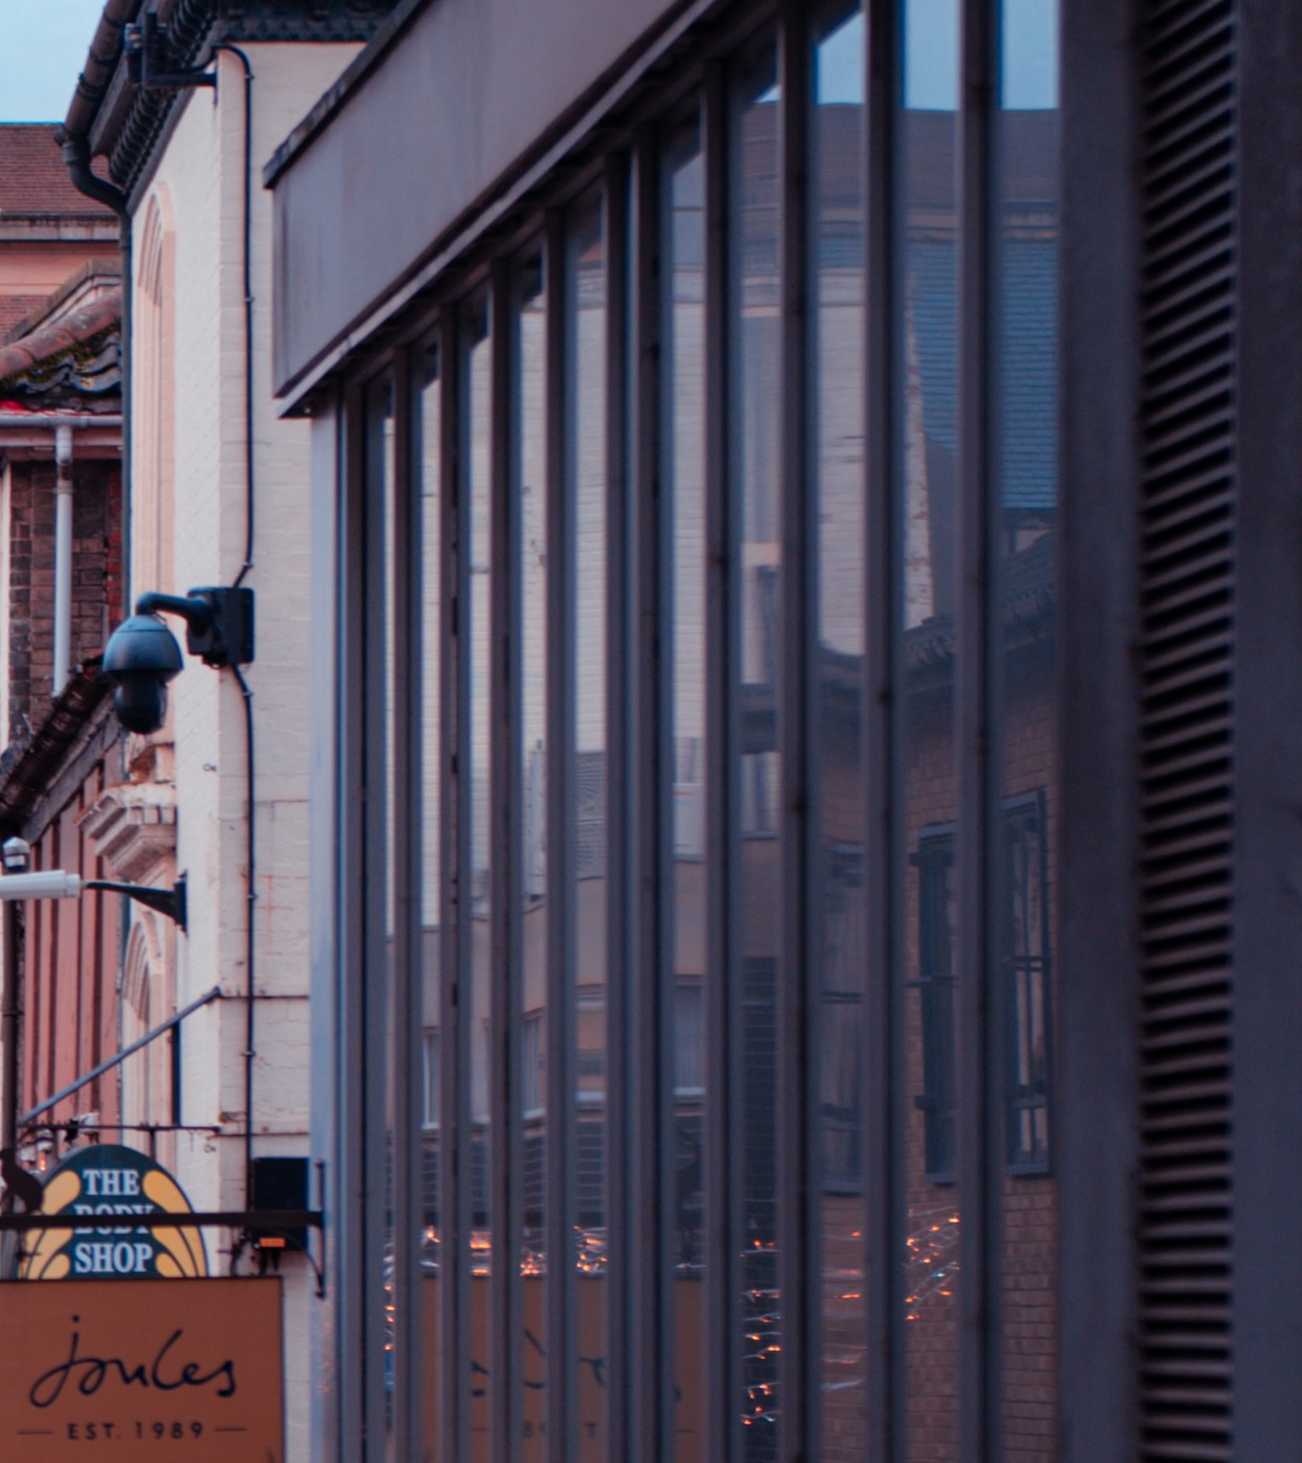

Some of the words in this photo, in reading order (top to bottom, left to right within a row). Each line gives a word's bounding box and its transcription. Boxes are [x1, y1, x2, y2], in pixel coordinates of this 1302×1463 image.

[83, 1169, 140, 1195] THE
[74, 1204, 154, 1234] BODY
[75, 1242, 154, 1273] SHOP
[29, 1314, 237, 1408] joules
[68, 1424, 122, 1440] EST.
[135, 1422, 204, 1438] 1989
